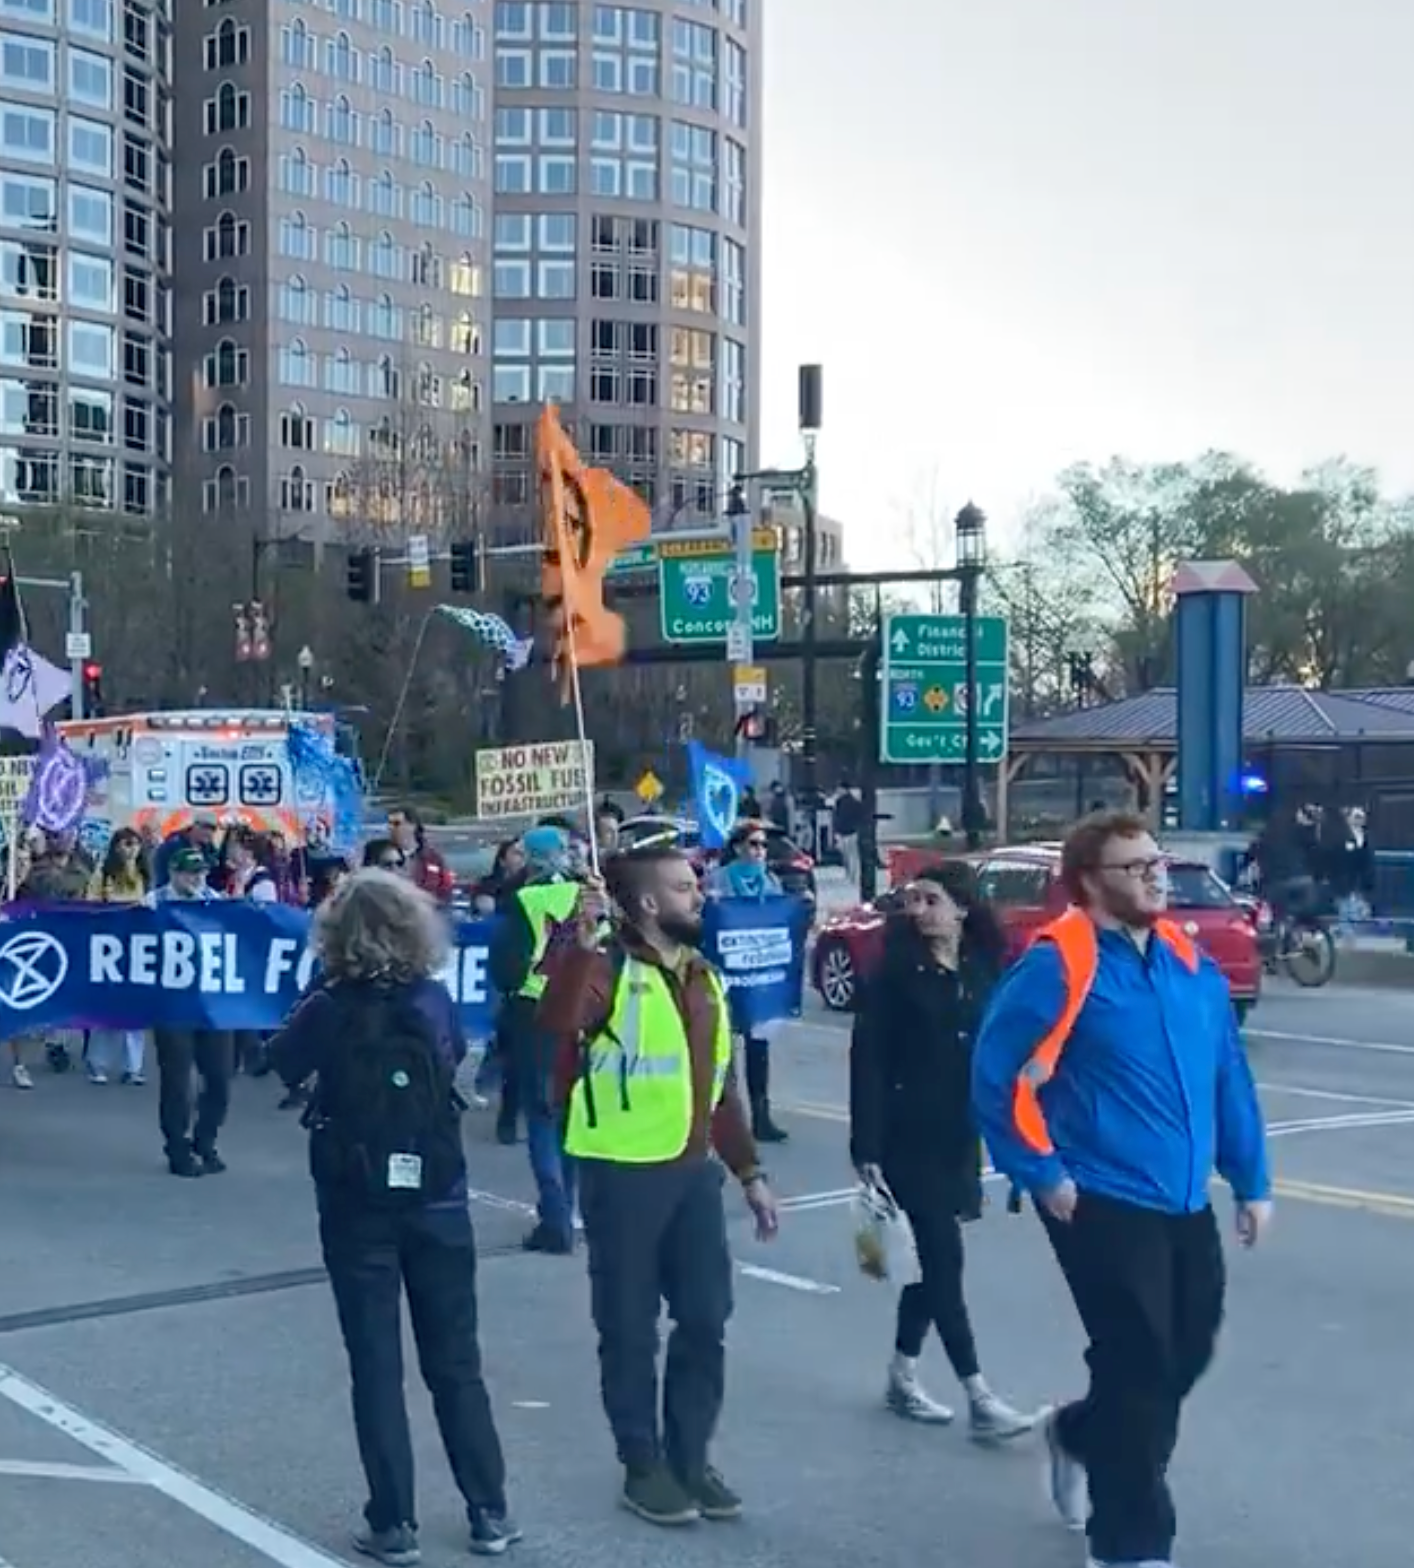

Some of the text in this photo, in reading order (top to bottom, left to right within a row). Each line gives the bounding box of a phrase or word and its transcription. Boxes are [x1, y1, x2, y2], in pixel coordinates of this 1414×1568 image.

[687, 583, 709, 603] 93
[673, 619, 734, 633] Concor
[918, 624, 984, 639] Financl
[917, 643, 965, 657] Distric
[502, 744, 568, 770] NO NEW
[481, 772, 542, 798] FOSSIL
[90, 931, 245, 993] REBEL
[264, 937, 319, 993] FO
